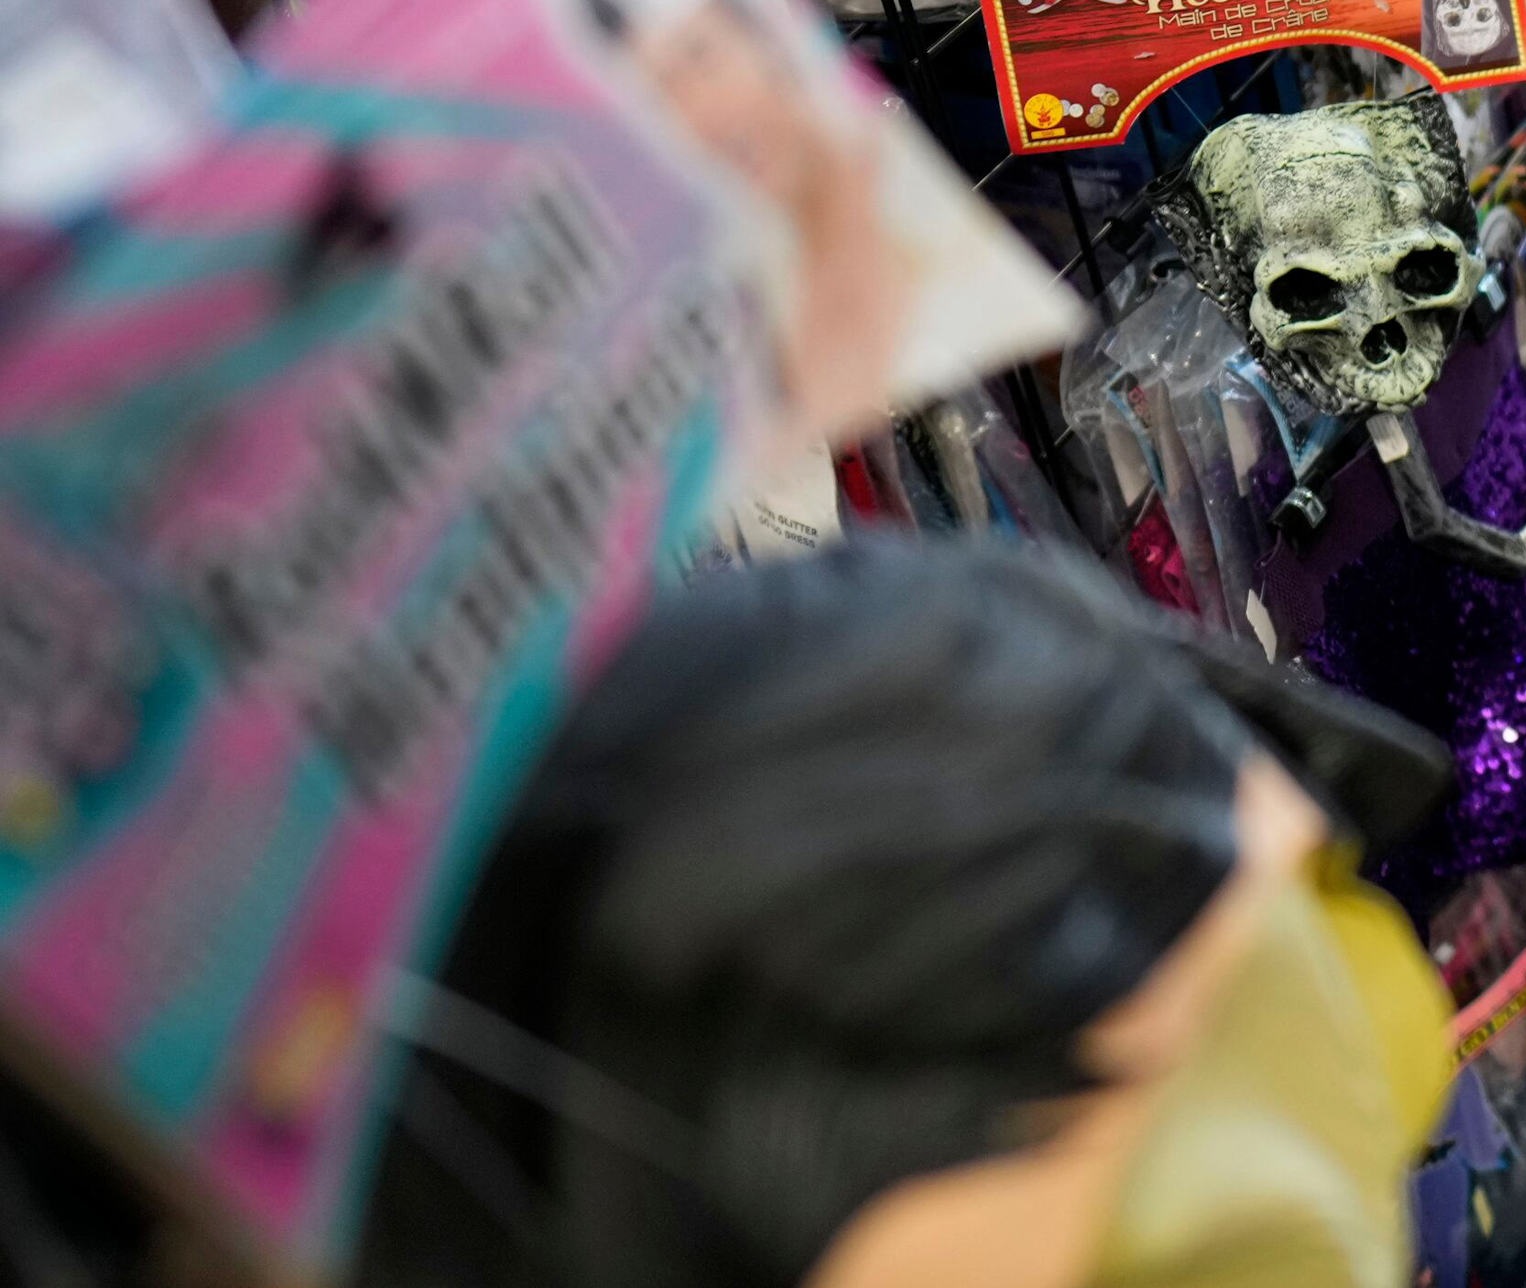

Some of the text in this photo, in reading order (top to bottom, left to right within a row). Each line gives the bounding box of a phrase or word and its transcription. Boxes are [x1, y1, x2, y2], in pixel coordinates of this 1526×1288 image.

[1159, 9, 1218, 30] Main
[1224, 3, 1257, 22] de
[1211, 22, 1243, 40] de
